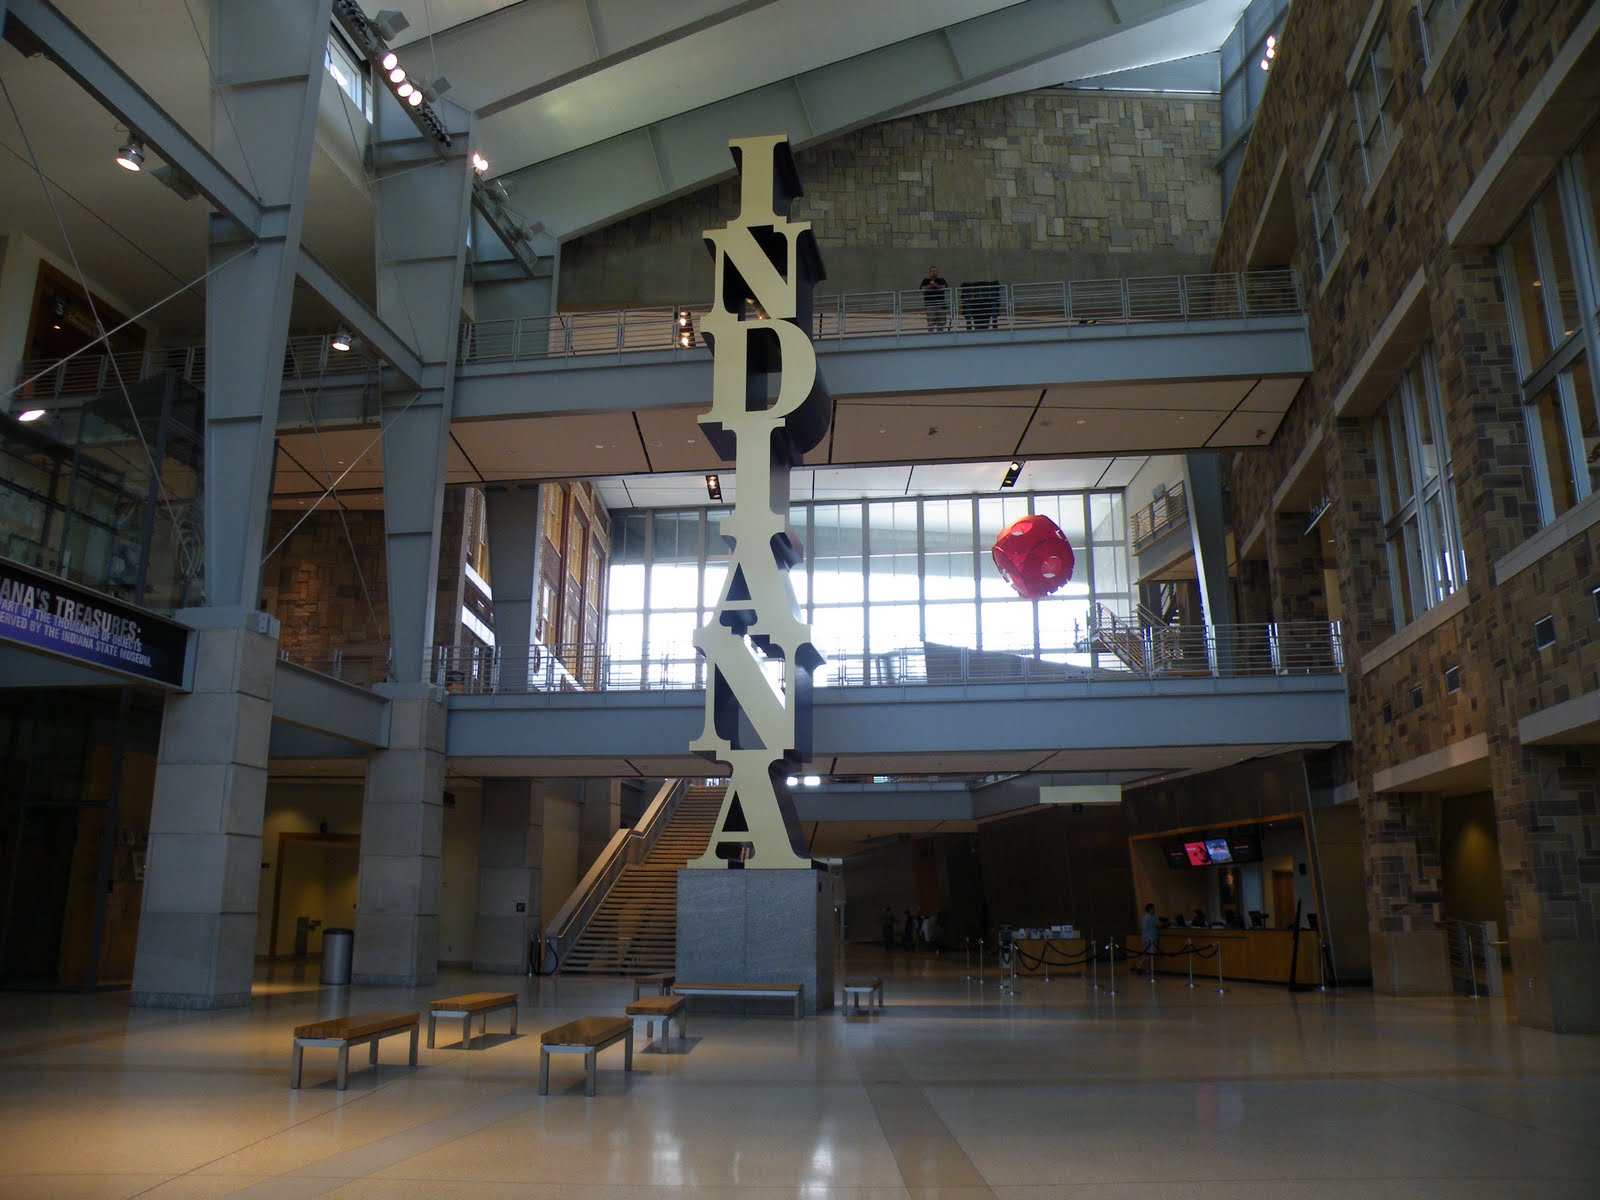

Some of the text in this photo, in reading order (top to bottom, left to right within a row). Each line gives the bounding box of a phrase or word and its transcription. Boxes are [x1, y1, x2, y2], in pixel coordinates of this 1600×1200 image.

[687, 134, 818, 870] INDIANA
[0, 577, 142, 642] ANA'S TREASURES:
[22, 604, 33, 618] OF
[35, 608, 52, 624] THE
[53, 614, 100, 639] THOUSANDS
[101, 630, 111, 642] OF
[112, 634, 142, 652] OBJECTS
[30, 619, 42, 633] BY
[44, 624, 60, 639] THE
[61, 629, 94, 650] INDIANA
[95, 640, 119, 657] STATE
